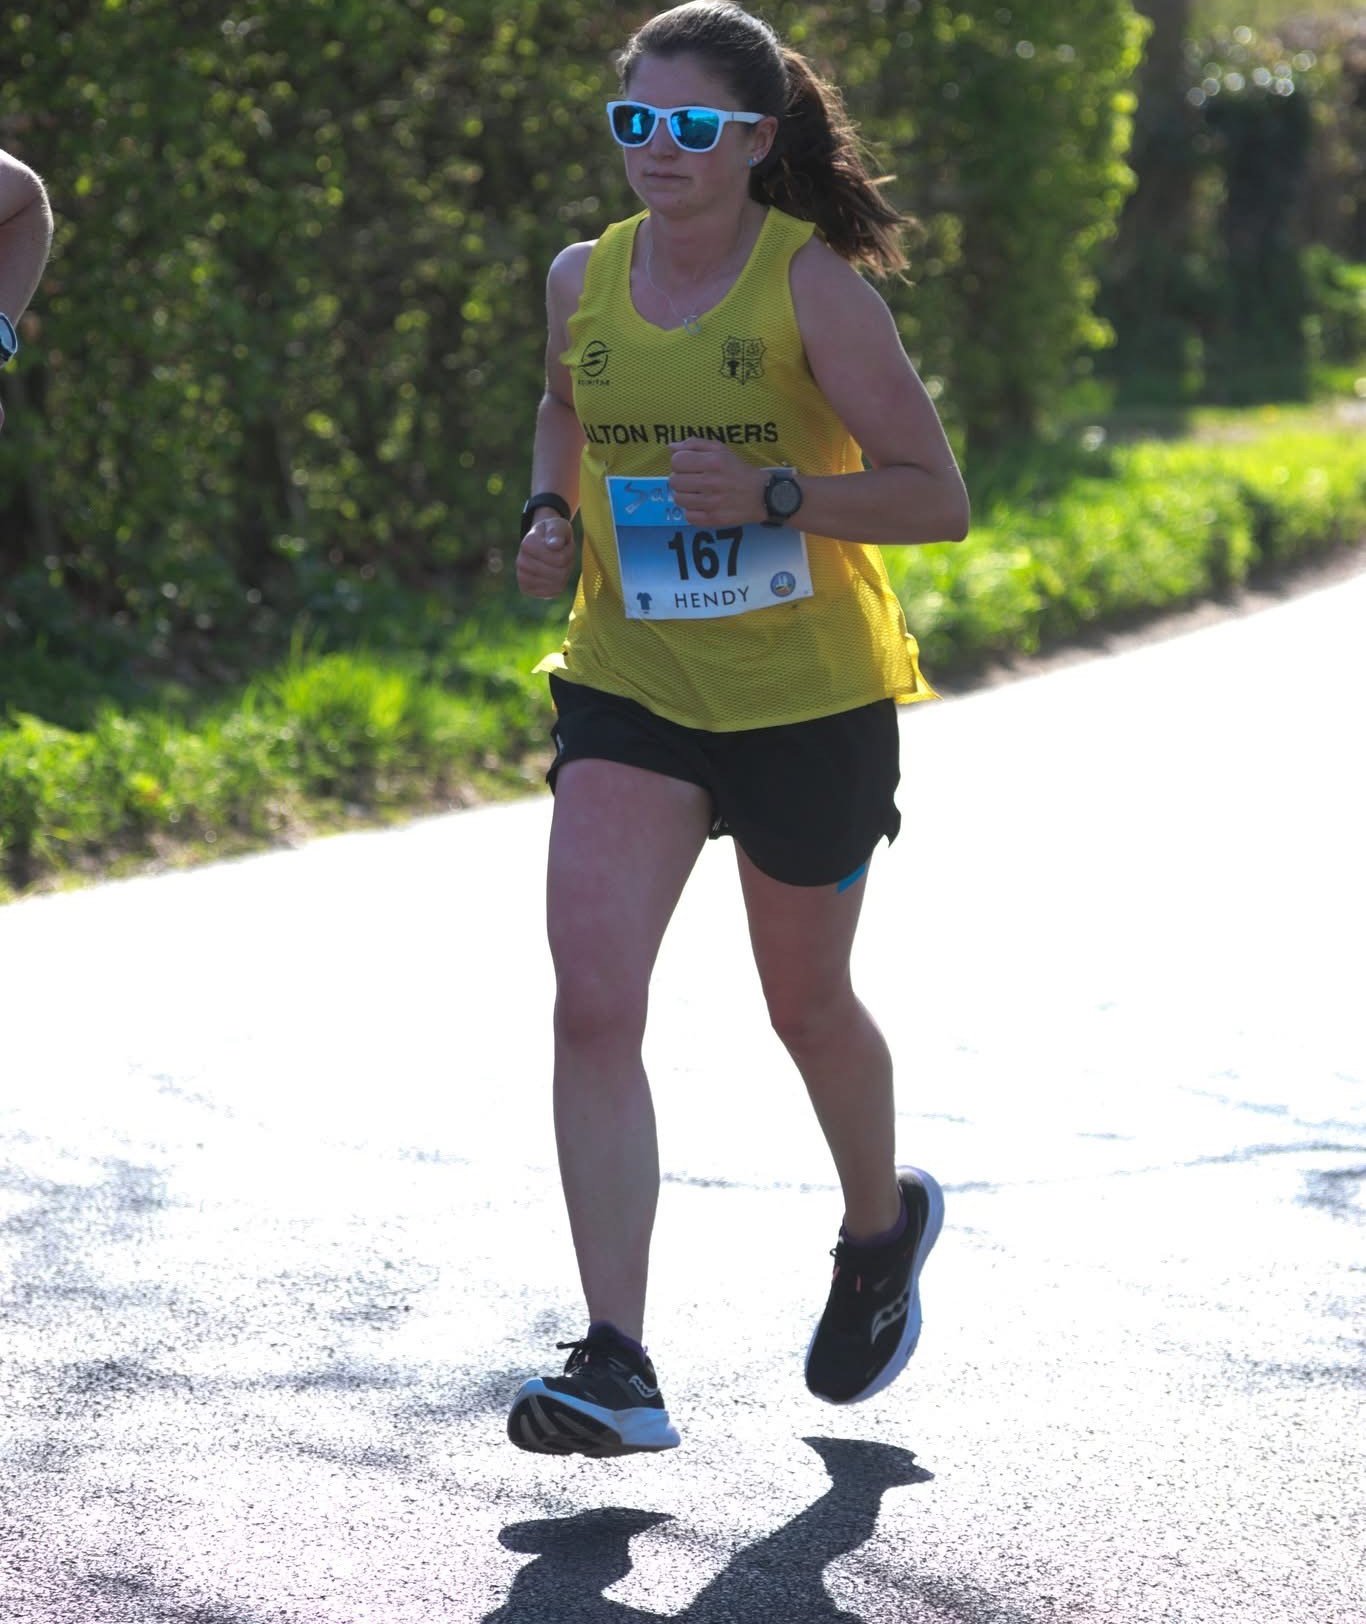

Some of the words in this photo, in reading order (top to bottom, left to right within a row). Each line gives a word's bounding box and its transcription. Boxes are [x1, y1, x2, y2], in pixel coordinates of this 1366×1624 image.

[653, 421, 778, 445] RUNNERS
[667, 526, 744, 581] 167
[674, 586, 750, 609] HENDY
